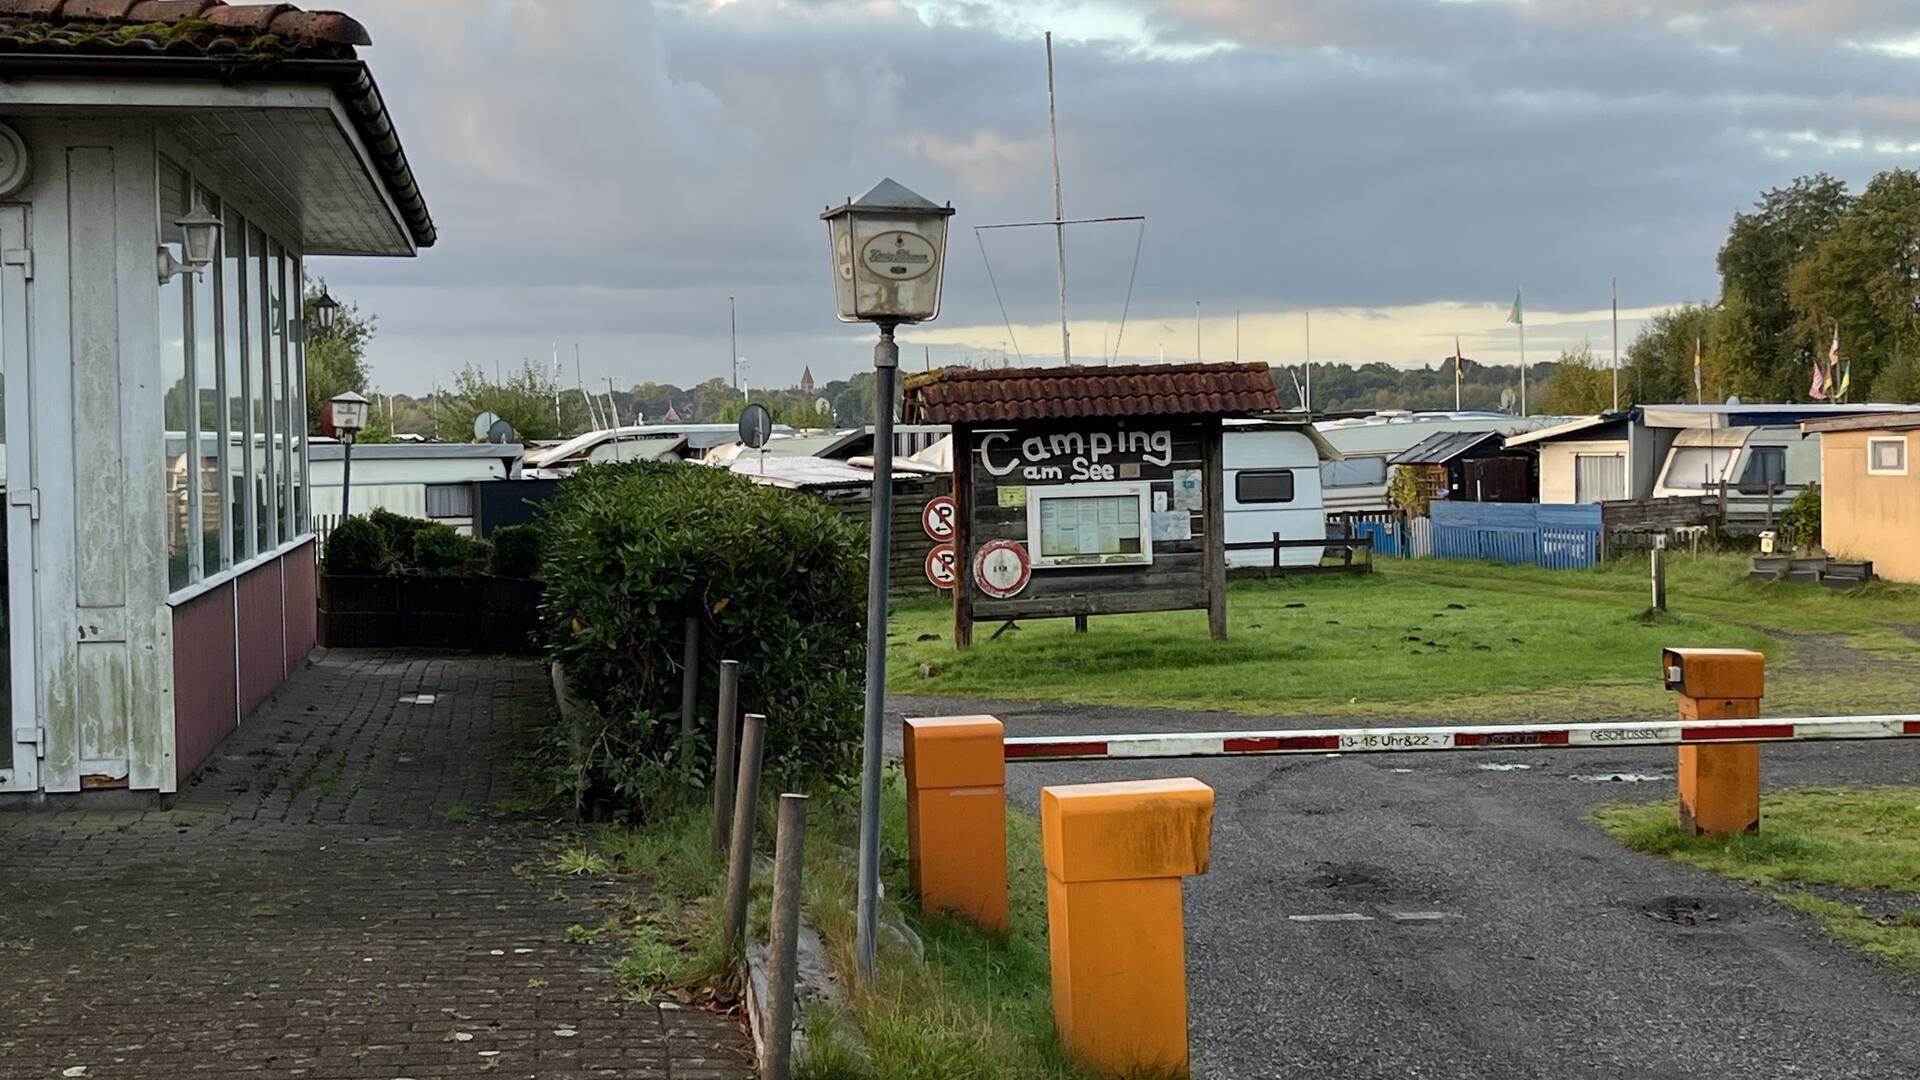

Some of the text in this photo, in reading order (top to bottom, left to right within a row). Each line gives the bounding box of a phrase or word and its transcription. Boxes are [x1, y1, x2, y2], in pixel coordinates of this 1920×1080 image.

[980, 421, 1172, 476] Camping
[1023, 456, 1115, 481] am See
[939, 507, 952, 523] P
[941, 554, 954, 571] P
